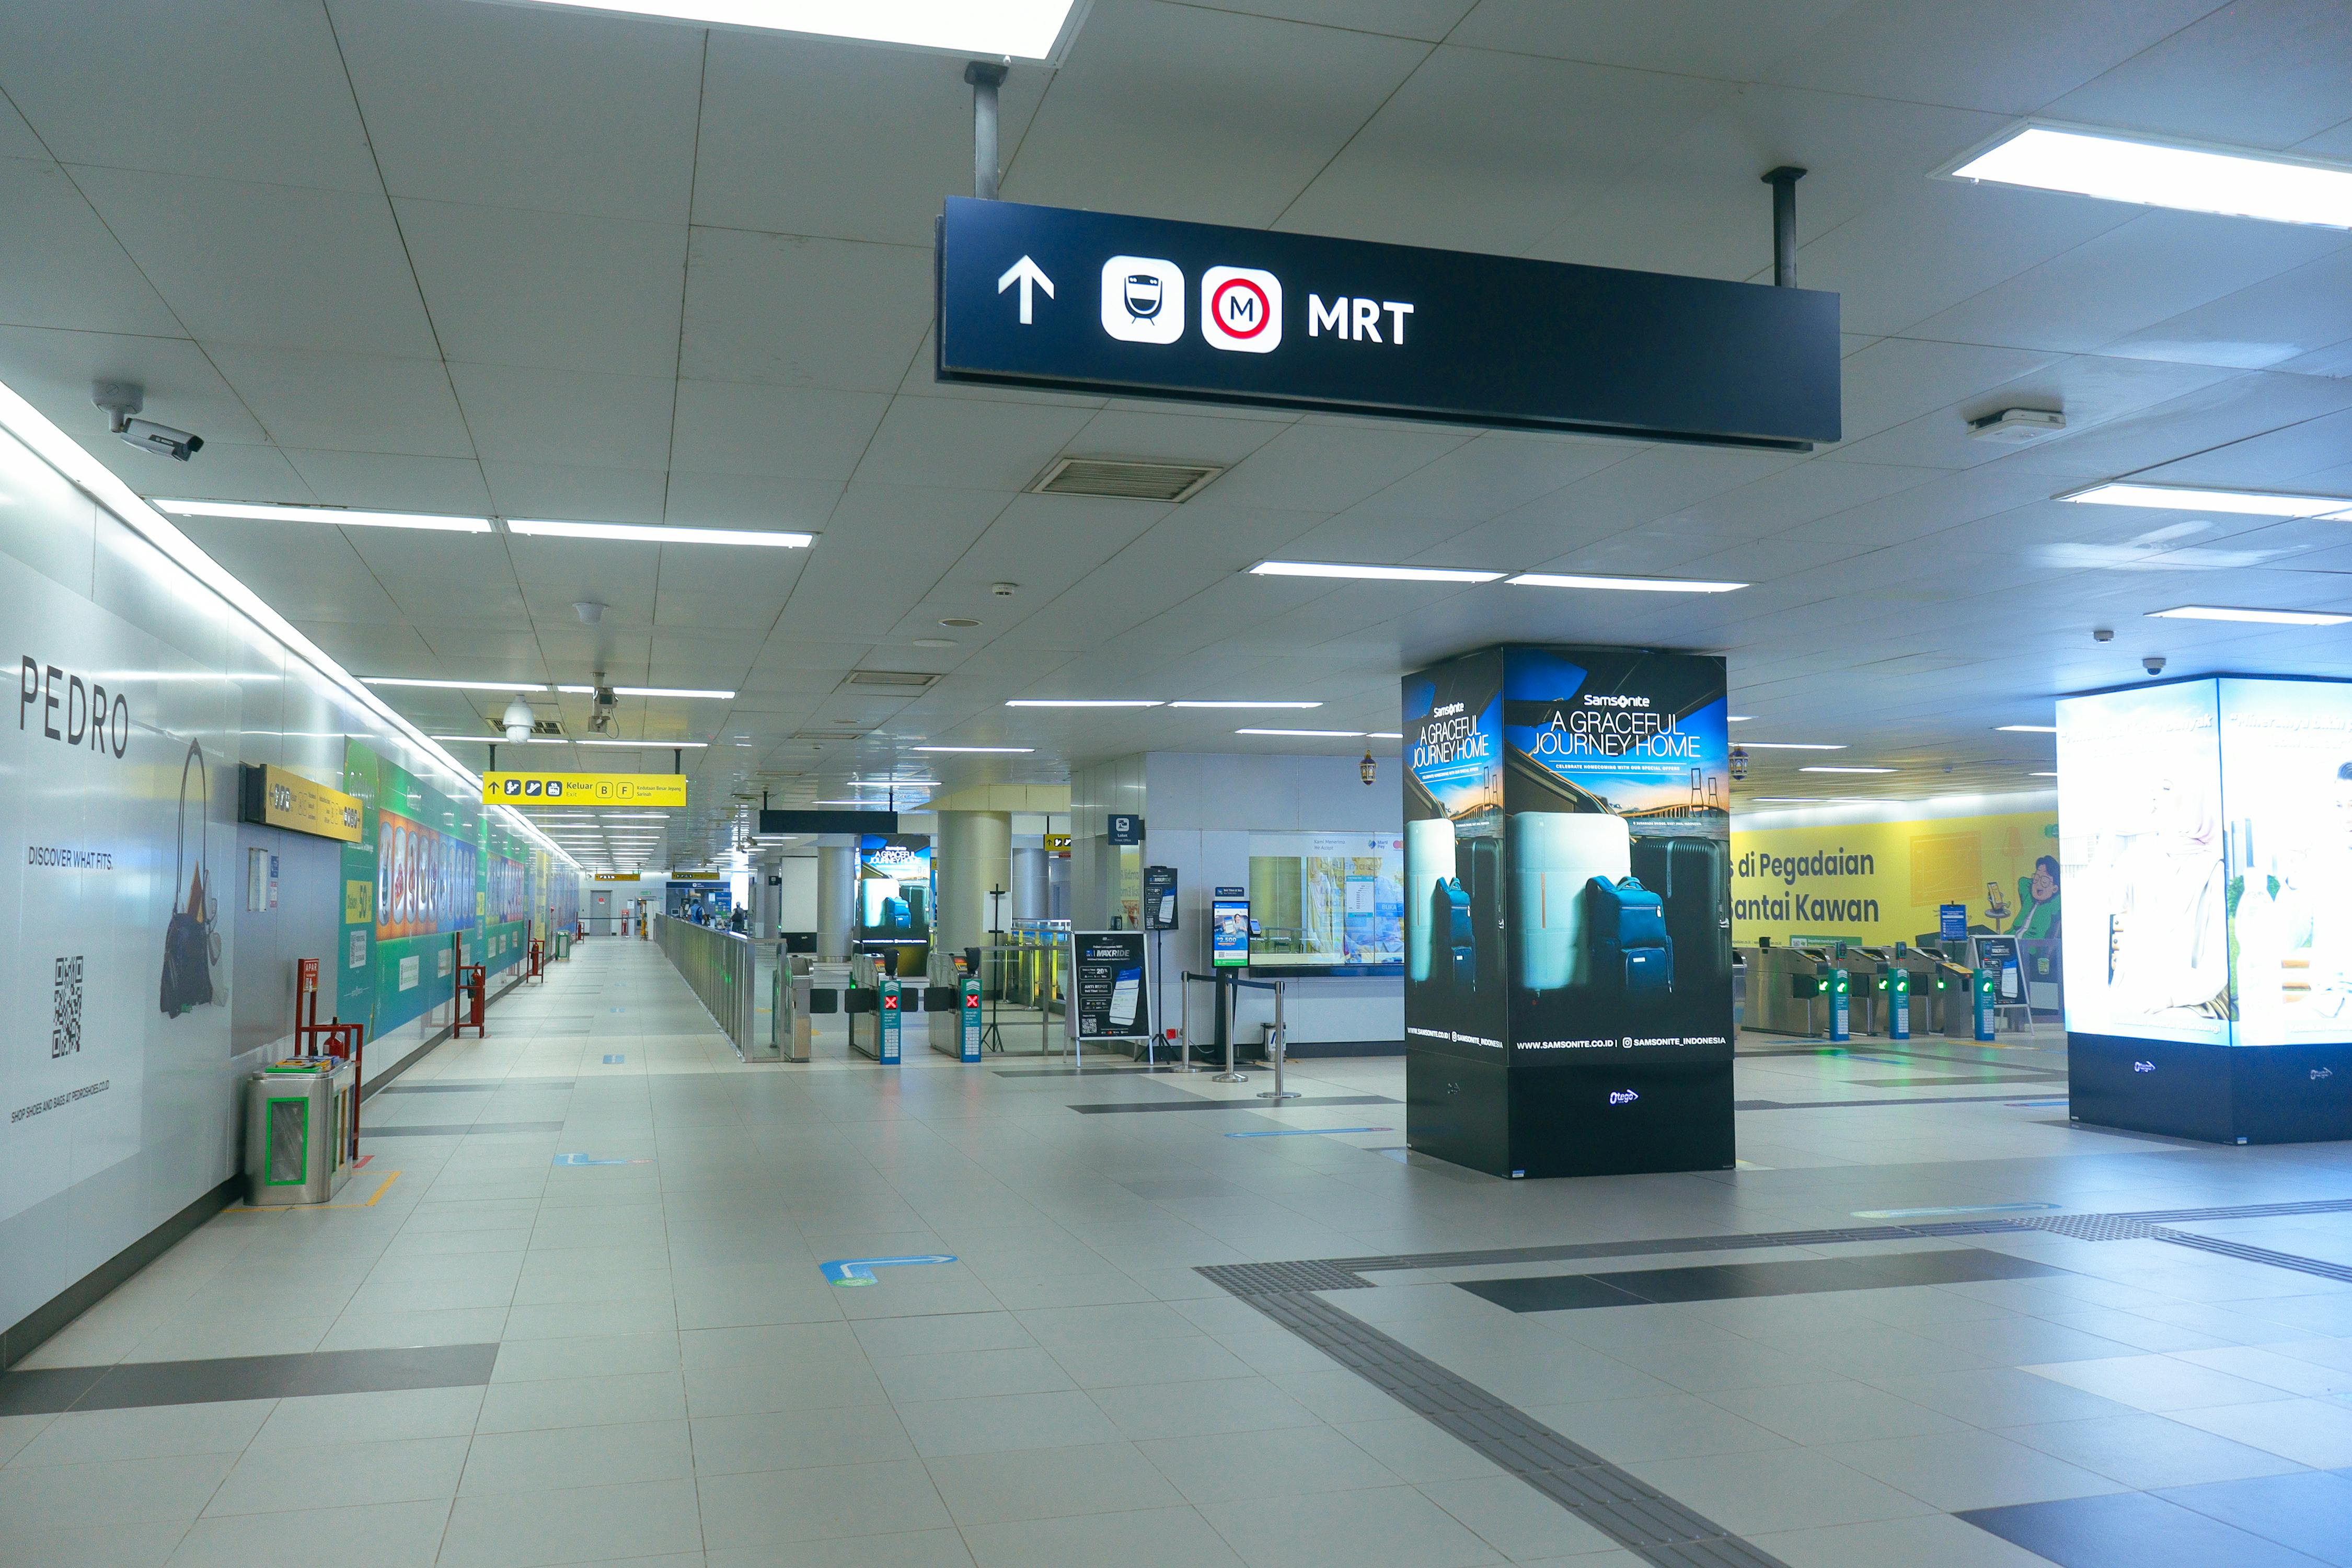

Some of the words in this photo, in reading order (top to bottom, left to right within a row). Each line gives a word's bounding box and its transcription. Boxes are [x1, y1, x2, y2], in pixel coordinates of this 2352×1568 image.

[1230, 295, 1253, 322] M
[1308, 293, 1415, 345] MRT
[20, 654, 129, 759] PEDRO
[1434, 702, 1465, 718] Samsonite
[1583, 694, 1650, 708] Samsonite
[1420, 726, 1427, 746] A
[1428, 714, 1481, 745] GRACEFUL
[1550, 710, 1567, 733] A
[1570, 711, 1686, 735] GRACEFUL
[1413, 740, 1456, 769] JOURNEY
[1457, 734, 1490, 760] HOME
[1532, 732, 1632, 756] JOURNEY
[1636, 735, 1702, 758] HOME
[601, 786, 607, 794] B
[29, 846, 72, 868] DISCOVER
[73, 850, 95, 869] WHAT
[96, 852, 113, 870] FITS.
[1738, 851, 1755, 878] di
[1760, 847, 1874, 885] Pegadaian
[1795, 894, 1879, 922] Kawan
[305, 963, 317, 971] APAR
[1407, 1027, 1448, 1040] WWW.SAMSONITE.CO.ID
[1457, 1034, 1504, 1048] SAMSONITE_INDONESIA
[1516, 1040, 1614, 1050] WWW.SAMSONITE.CO.ID
[1633, 1036, 1726, 1047] SAMSONITE_INDONESIA
[11, 1108, 25, 1123] SHOP
[26, 1102, 42, 1119] SHOES
[43, 1099, 52, 1112] AND
